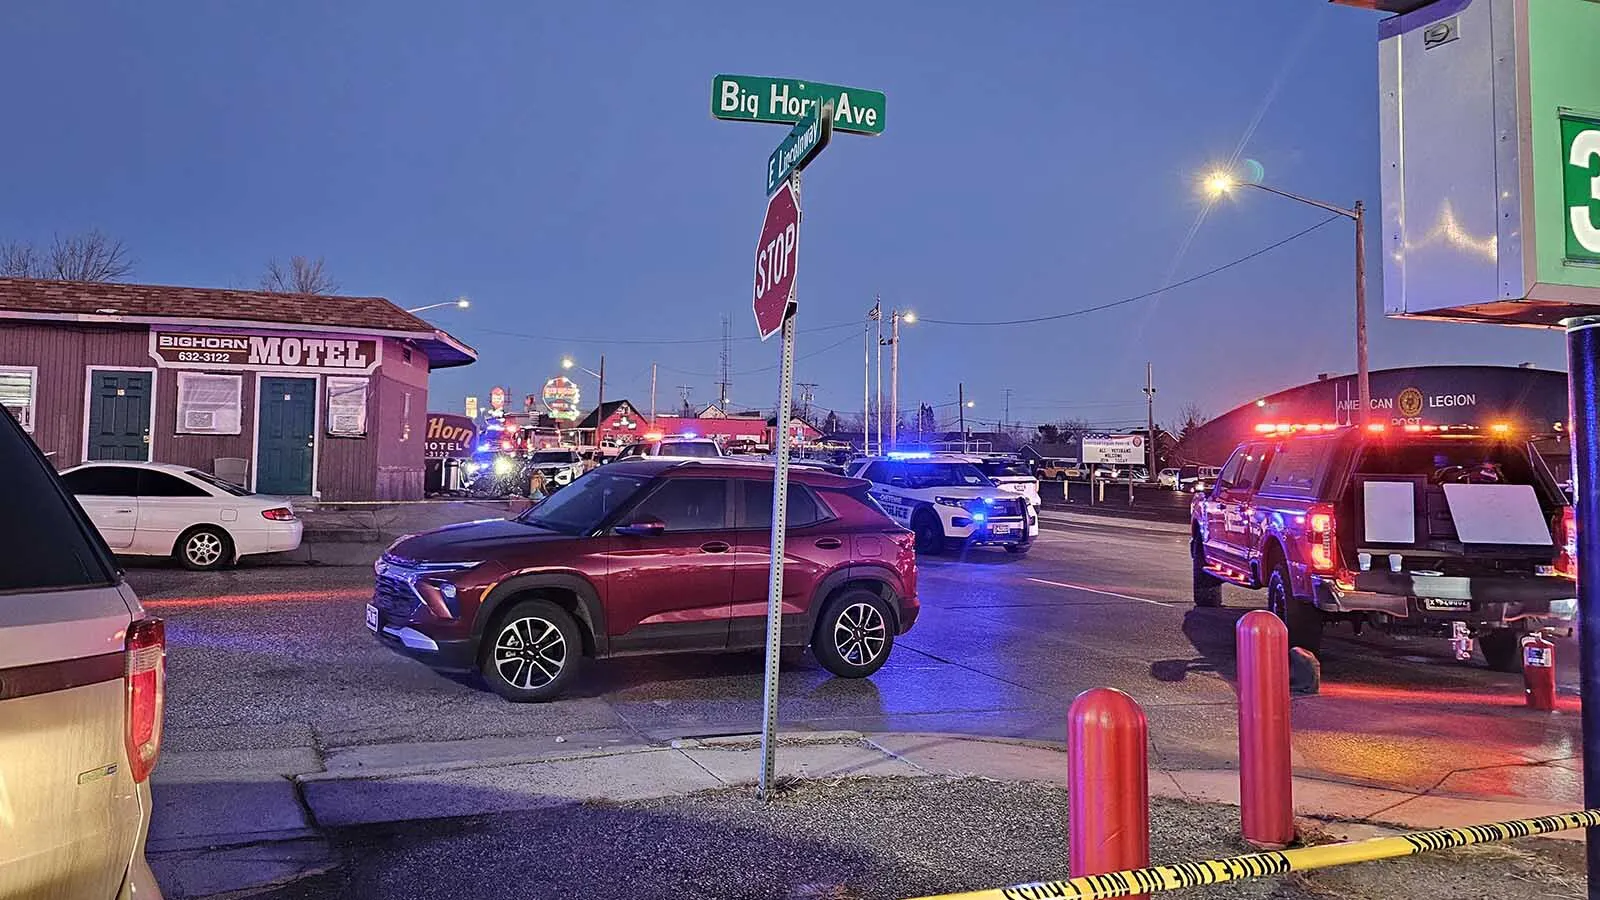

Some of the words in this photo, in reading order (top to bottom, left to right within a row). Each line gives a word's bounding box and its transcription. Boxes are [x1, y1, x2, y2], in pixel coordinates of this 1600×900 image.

[721, 80, 759, 118] Big
[770, 83, 818, 117] Hor
[834, 93, 878, 127] Ave
[768, 158, 776, 189] E
[777, 116, 820, 179] Lincolnway
[1569, 129, 1600, 254] 3
[756, 222, 796, 300] STOP
[159, 335, 248, 350] BIGHORN
[177, 351, 230, 363] 632-3122
[248, 335, 367, 368] MOTEL
[1337, 397, 1393, 411] AMECAN
[1428, 393, 1477, 409] LEGION
[427, 417, 474, 449] Horn
[1215, 850, 1292, 881] POLICE
